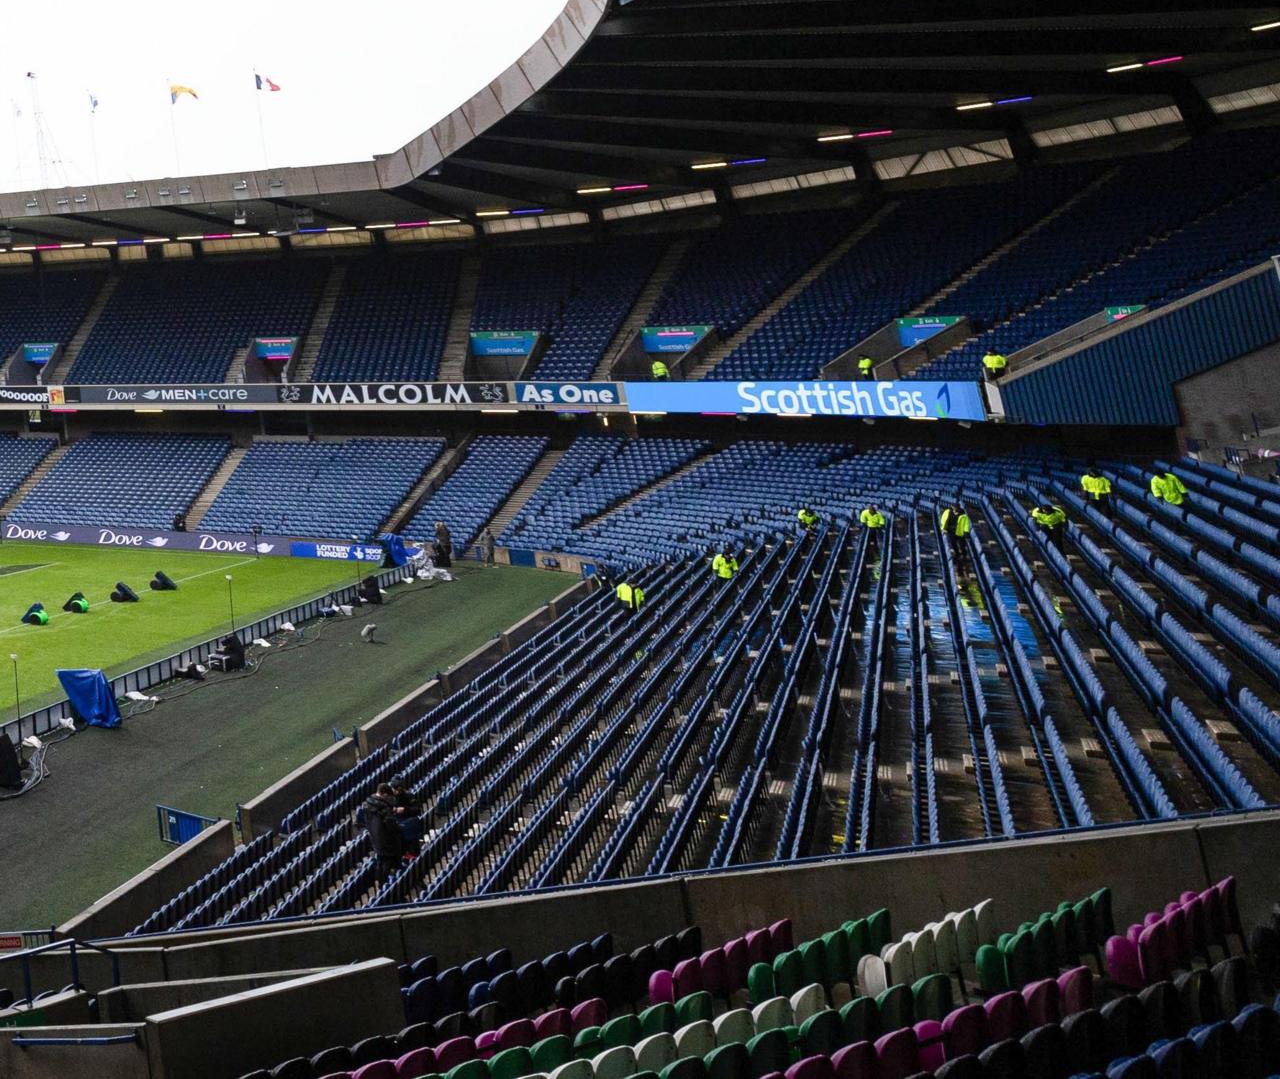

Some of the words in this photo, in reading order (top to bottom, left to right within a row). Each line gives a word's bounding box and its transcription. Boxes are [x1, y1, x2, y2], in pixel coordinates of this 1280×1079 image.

[107, 388, 137, 401] Dove
[162, 387, 248, 400] MEN+care
[311, 384, 472, 404] MALCOLM
[522, 384, 553, 402] As
[559, 384, 614, 403] One
[737, 381, 874, 415] Scottish
[877, 381, 927, 418] Gas
[6, 524, 47, 540] Dove
[99, 529, 143, 545] Dove
[199, 535, 246, 552] Dove
[316, 544, 351, 552] LOTTERY
[317, 551, 348, 559] FUNDED
